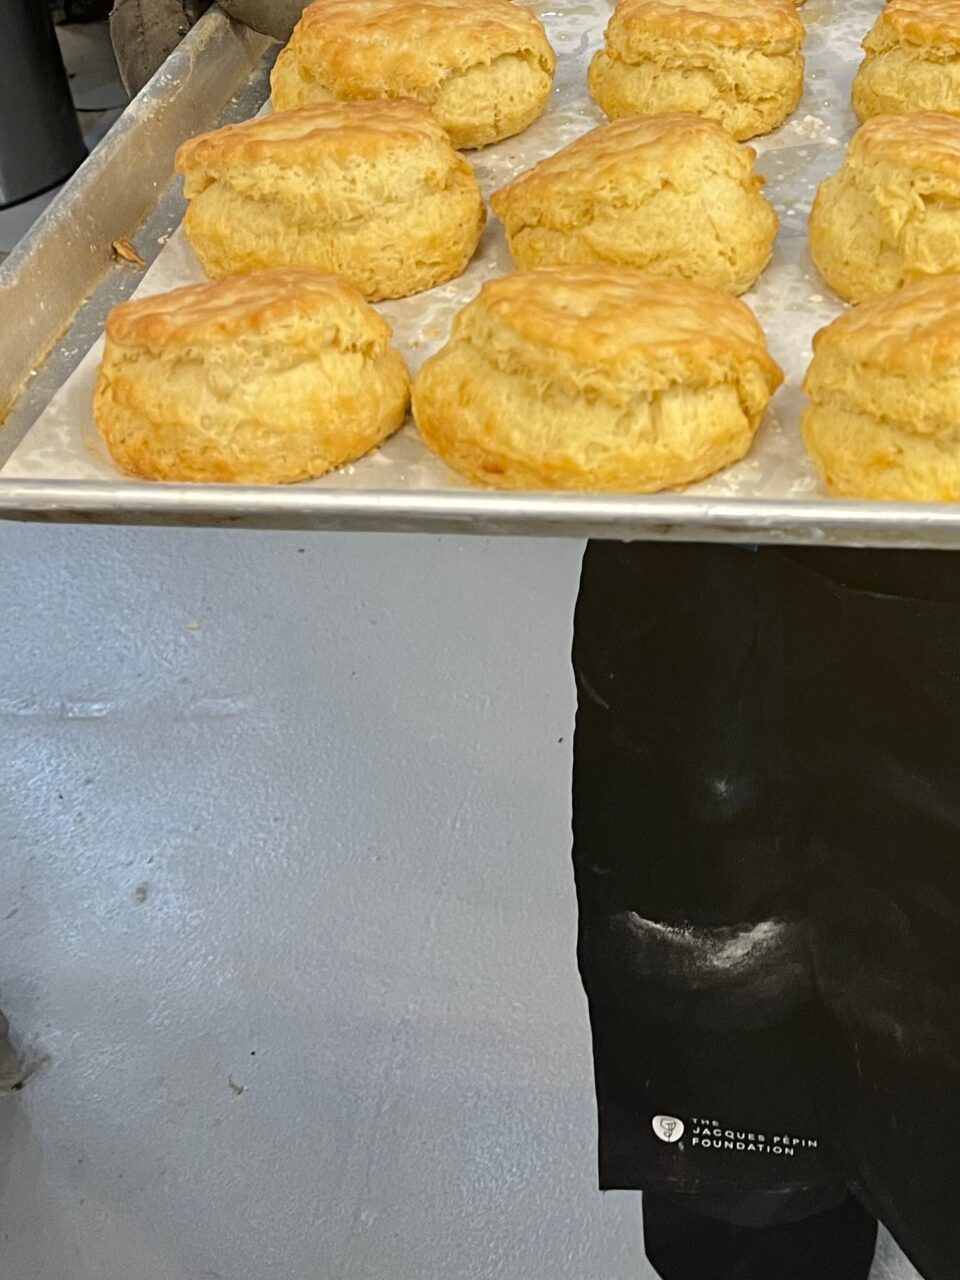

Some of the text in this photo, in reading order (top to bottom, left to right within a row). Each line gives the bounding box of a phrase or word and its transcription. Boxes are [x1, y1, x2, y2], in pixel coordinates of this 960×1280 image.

[692, 1118, 720, 1127] THE
[691, 1137, 794, 1156] FOUNDATION
[692, 1126, 818, 1148] JACQUES PÉPIN
